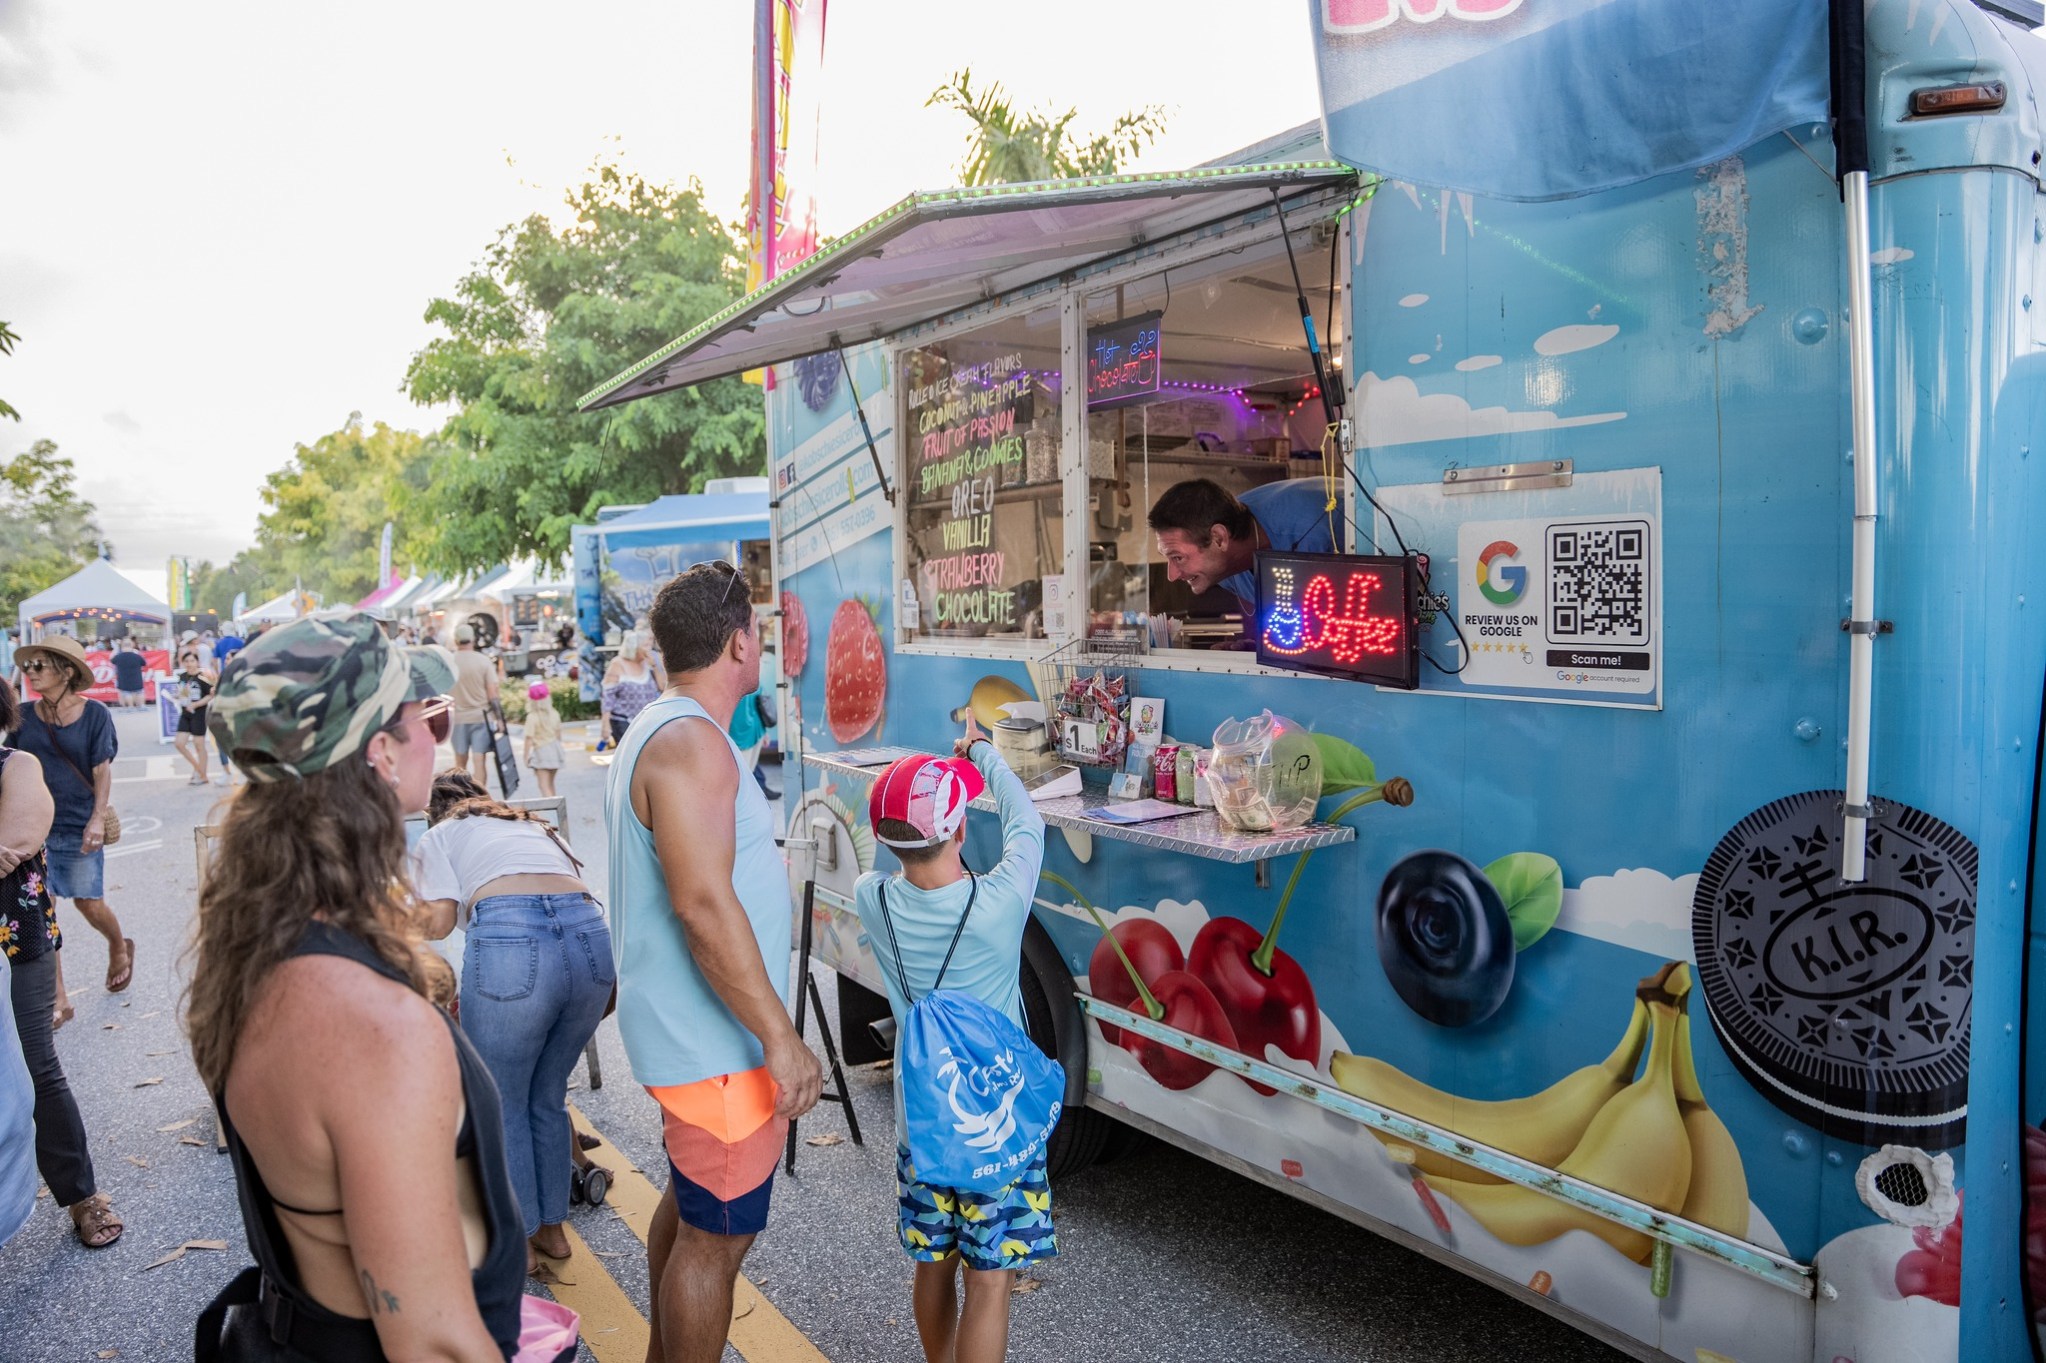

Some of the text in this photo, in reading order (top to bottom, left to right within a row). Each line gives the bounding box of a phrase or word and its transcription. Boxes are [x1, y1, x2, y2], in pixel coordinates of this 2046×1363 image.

[1095, 339, 1121, 368] Hot
[935, 376, 949, 397] ICE
[981, 352, 1022, 379] FLAVORS
[1088, 354, 1139, 393] Chocolate
[970, 374, 1031, 413] PINEAPPLE
[922, 406, 1016, 460] FRUIT OF PASSION
[943, 513, 991, 551] VANILLA
[923, 551, 1005, 591] STRAWBERRY
[935, 589, 1017, 625] CHOCOLATE
[1418, 591, 1449, 611] chie's
[1465, 615, 1538, 626] REVIEW US ON
[1480, 626, 1522, 637] GOOGLE
[1557, 670, 1588, 684] Google
[1614, 675, 1640, 684] required
[1571, 654, 1622, 666] Scan me!
[1081, 744, 1098, 755] Each
[1791, 910, 1909, 983] K.I.R.
